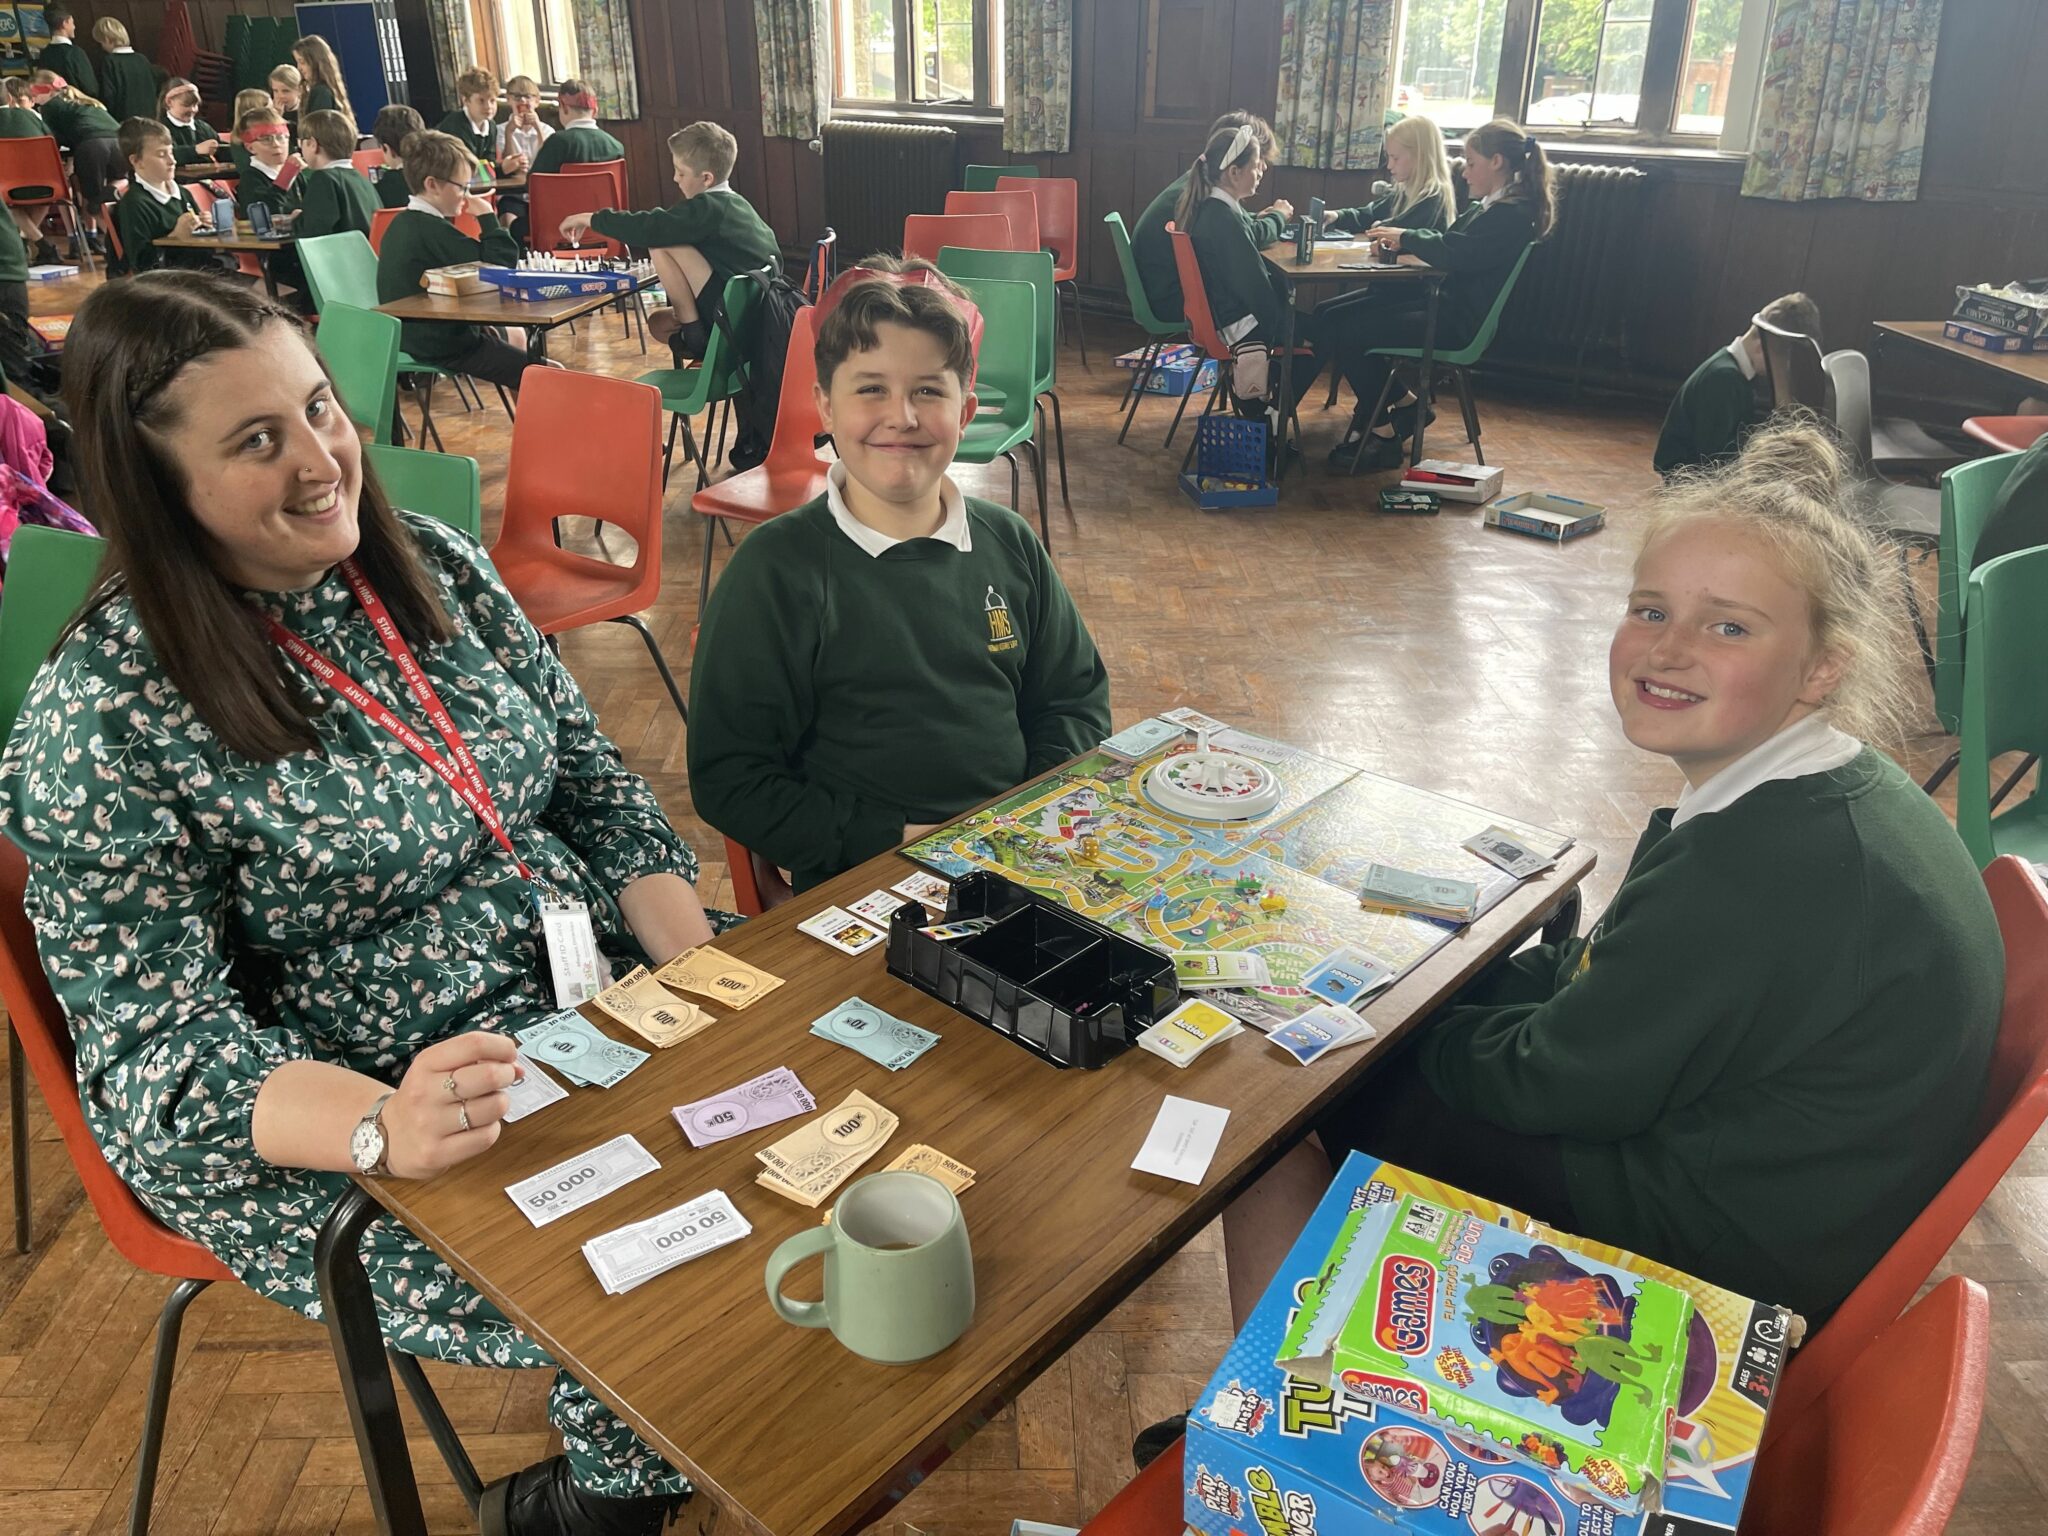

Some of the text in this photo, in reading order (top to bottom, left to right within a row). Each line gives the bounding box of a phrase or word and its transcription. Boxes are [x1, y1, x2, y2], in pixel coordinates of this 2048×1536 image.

[359, 585, 375, 605] HMS
[377, 616, 397, 641] STAFF
[285, 639, 305, 657] HMS
[312, 660, 335, 679] QEHS
[398, 653, 416, 676] QEHS
[415, 681, 431, 700] HMS
[344, 685, 370, 708] STAFF
[380, 713, 398, 731] HMS
[433, 710, 453, 735] STAFF
[404, 732, 425, 752] QEHS
[433, 759, 455, 781] STAFF
[455, 746, 471, 769] QEHS
[470, 775, 484, 794] HMS
[463, 788, 478, 806] HMS
[620, 968, 648, 989] 100 000
[1329, 968, 1364, 987] Career
[1173, 1018, 1207, 1040] Action
[601, 1069, 627, 1086] 10 000
[794, 1089, 813, 1111] 50 000
[760, 1149, 787, 1169] 100 000
[942, 1159, 972, 1179] 500 000
[529, 1167, 596, 1207] 50 000
[1350, 1187, 1367, 1212] ON'T
[656, 1211, 728, 1249] 50 000
[1456, 1221, 1485, 1264] FLIP OUT!
[1383, 1261, 1430, 1353] Games
[1444, 1300, 1457, 1322] FLIP
[1436, 1355, 1455, 1381] GUESS
[1766, 1352, 1779, 1369] 2-4
[1739, 1368, 1751, 1388] AGES
[1748, 1374, 1770, 1398] 3+
[1234, 1395, 1260, 1432] MASTER
[1600, 1459, 1628, 1490] GUESS
[1201, 1474, 1220, 1511] PLAY
[1217, 1481, 1231, 1516] MASTER
[1449, 1462, 1469, 1518] HOLD YOUR
[1461, 1473, 1477, 1514] NERVE?
[1612, 1485, 1631, 1501] THE
[1579, 1503, 1592, 1536] OLL TO
